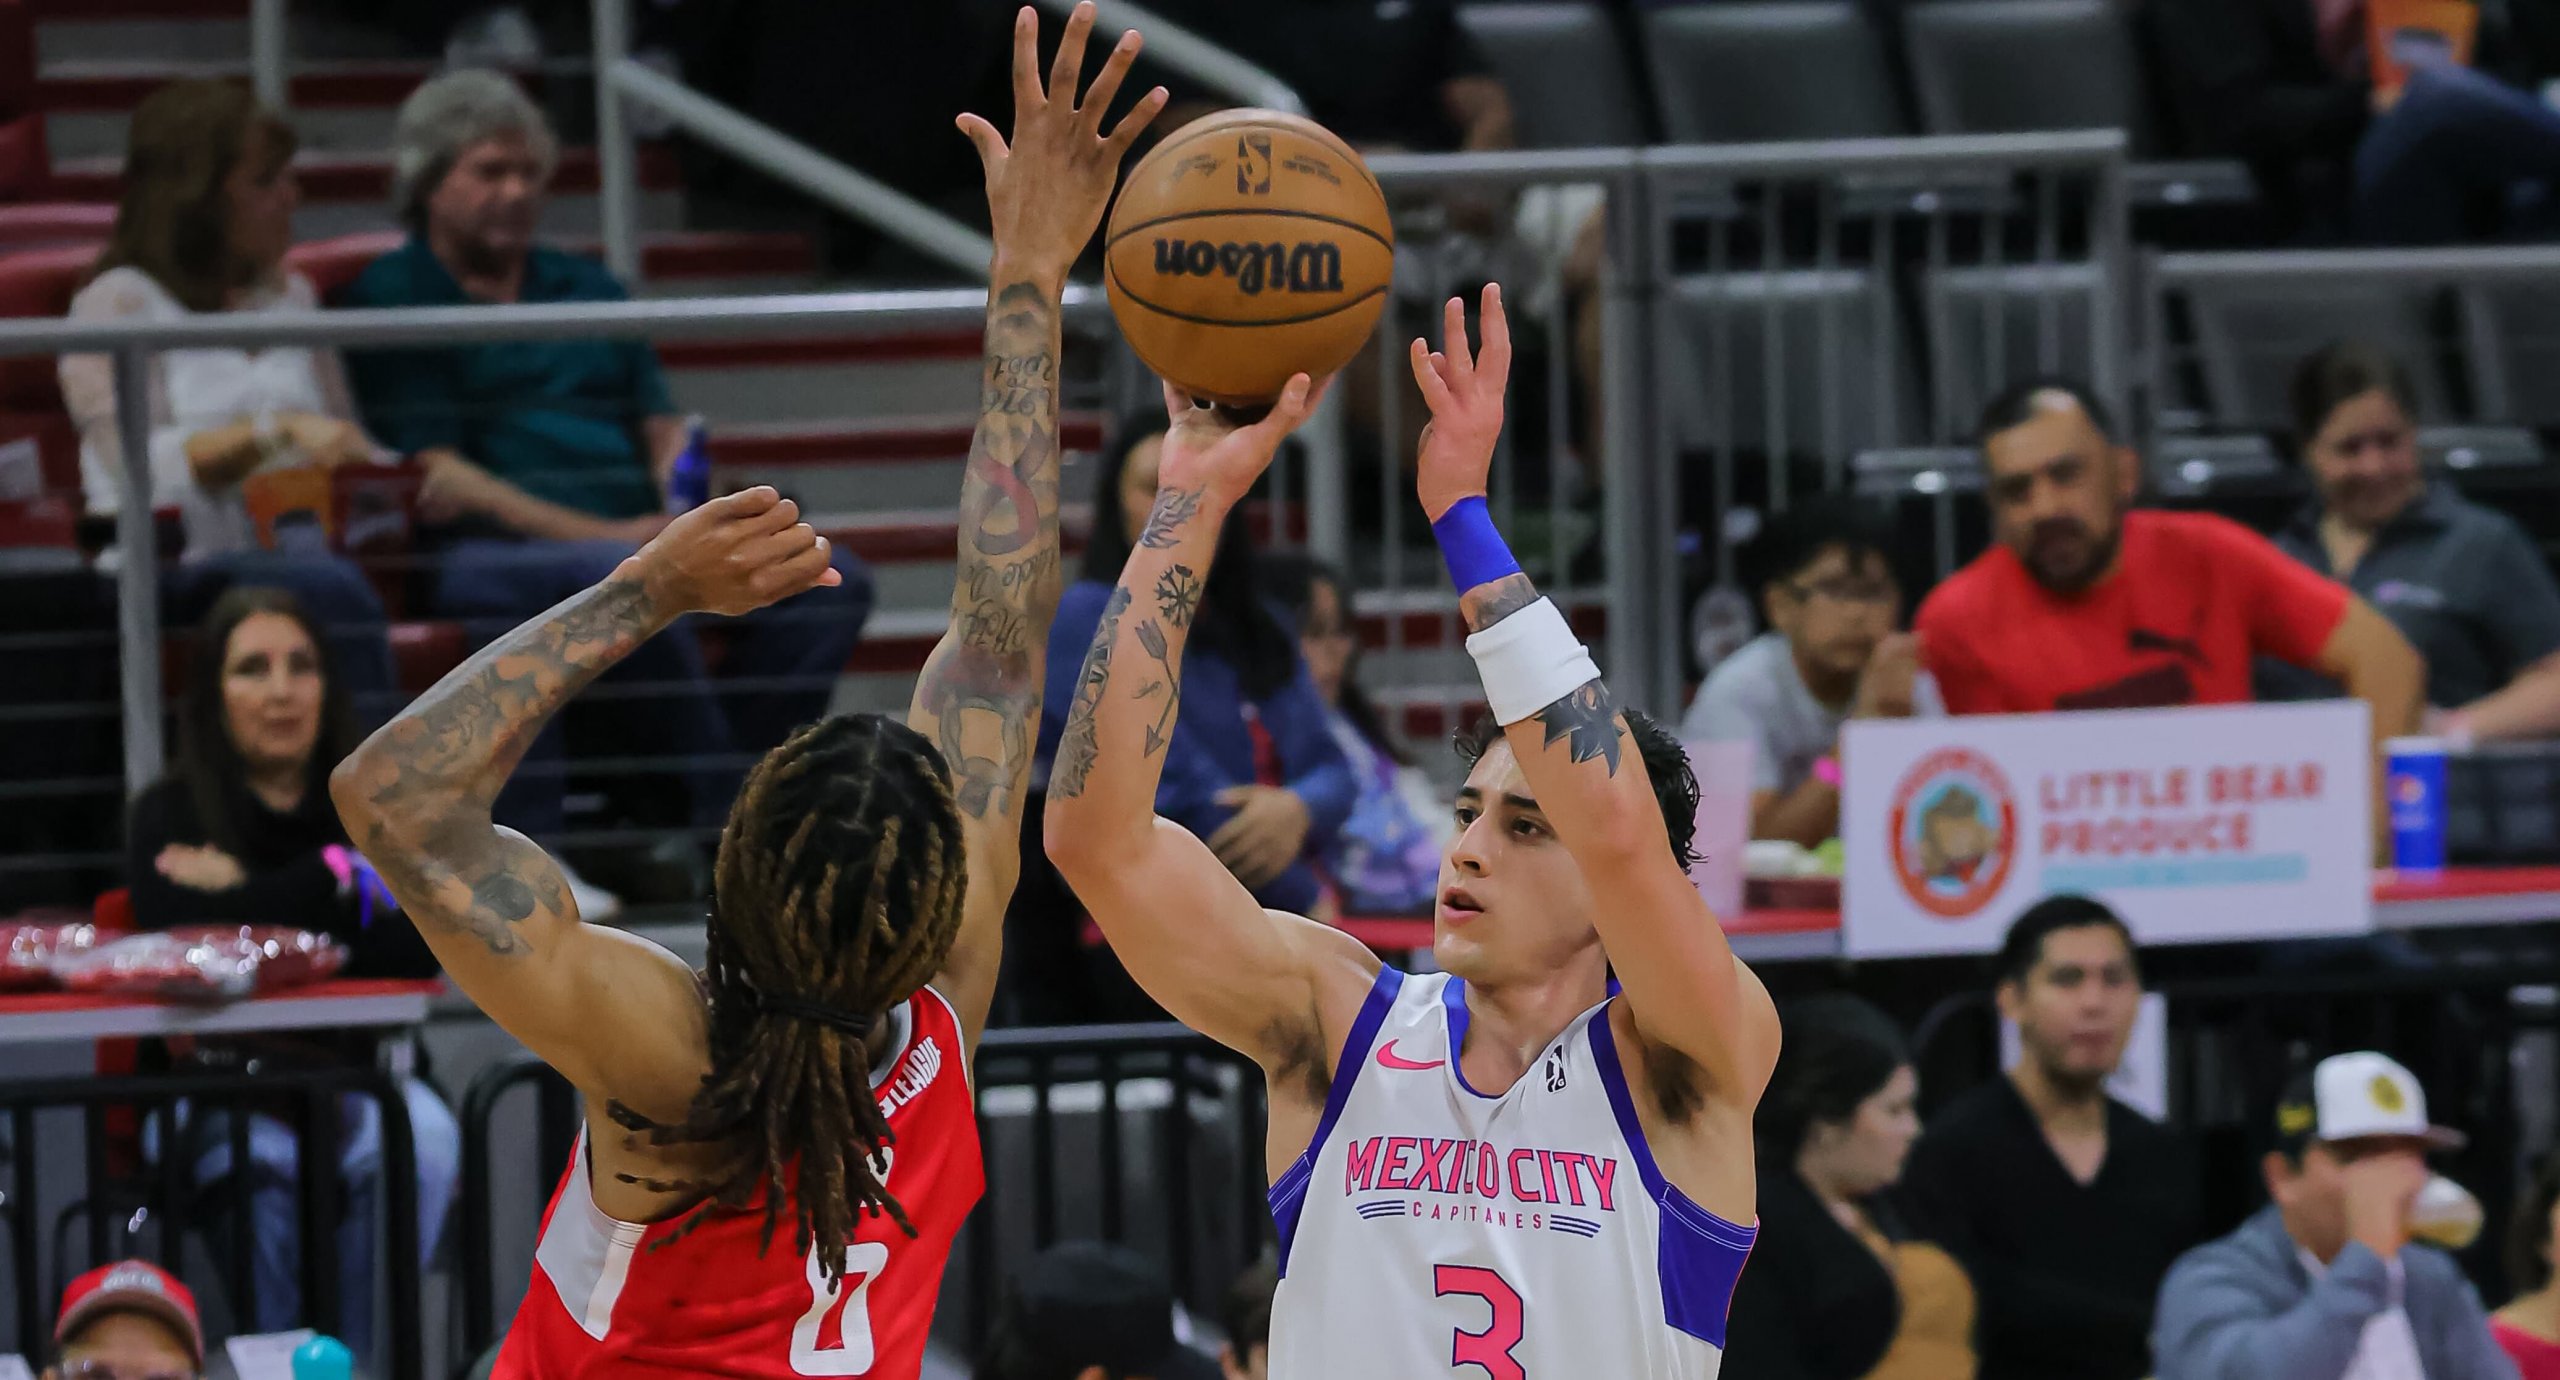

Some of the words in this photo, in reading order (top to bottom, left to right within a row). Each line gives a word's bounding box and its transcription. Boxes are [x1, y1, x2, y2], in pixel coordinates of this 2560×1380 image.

[1154, 238, 1344, 294] Wilson
[2039, 767, 2190, 813] LITTLE
[2207, 762, 2324, 804] BEAR
[2041, 812, 2253, 857] PRODUCE
[1346, 1136, 1499, 1199] MEXICO
[1507, 1148, 1617, 1211] CITY
[1413, 1201, 1542, 1229] CAPITANES
[1433, 1264, 1526, 1380] 3
